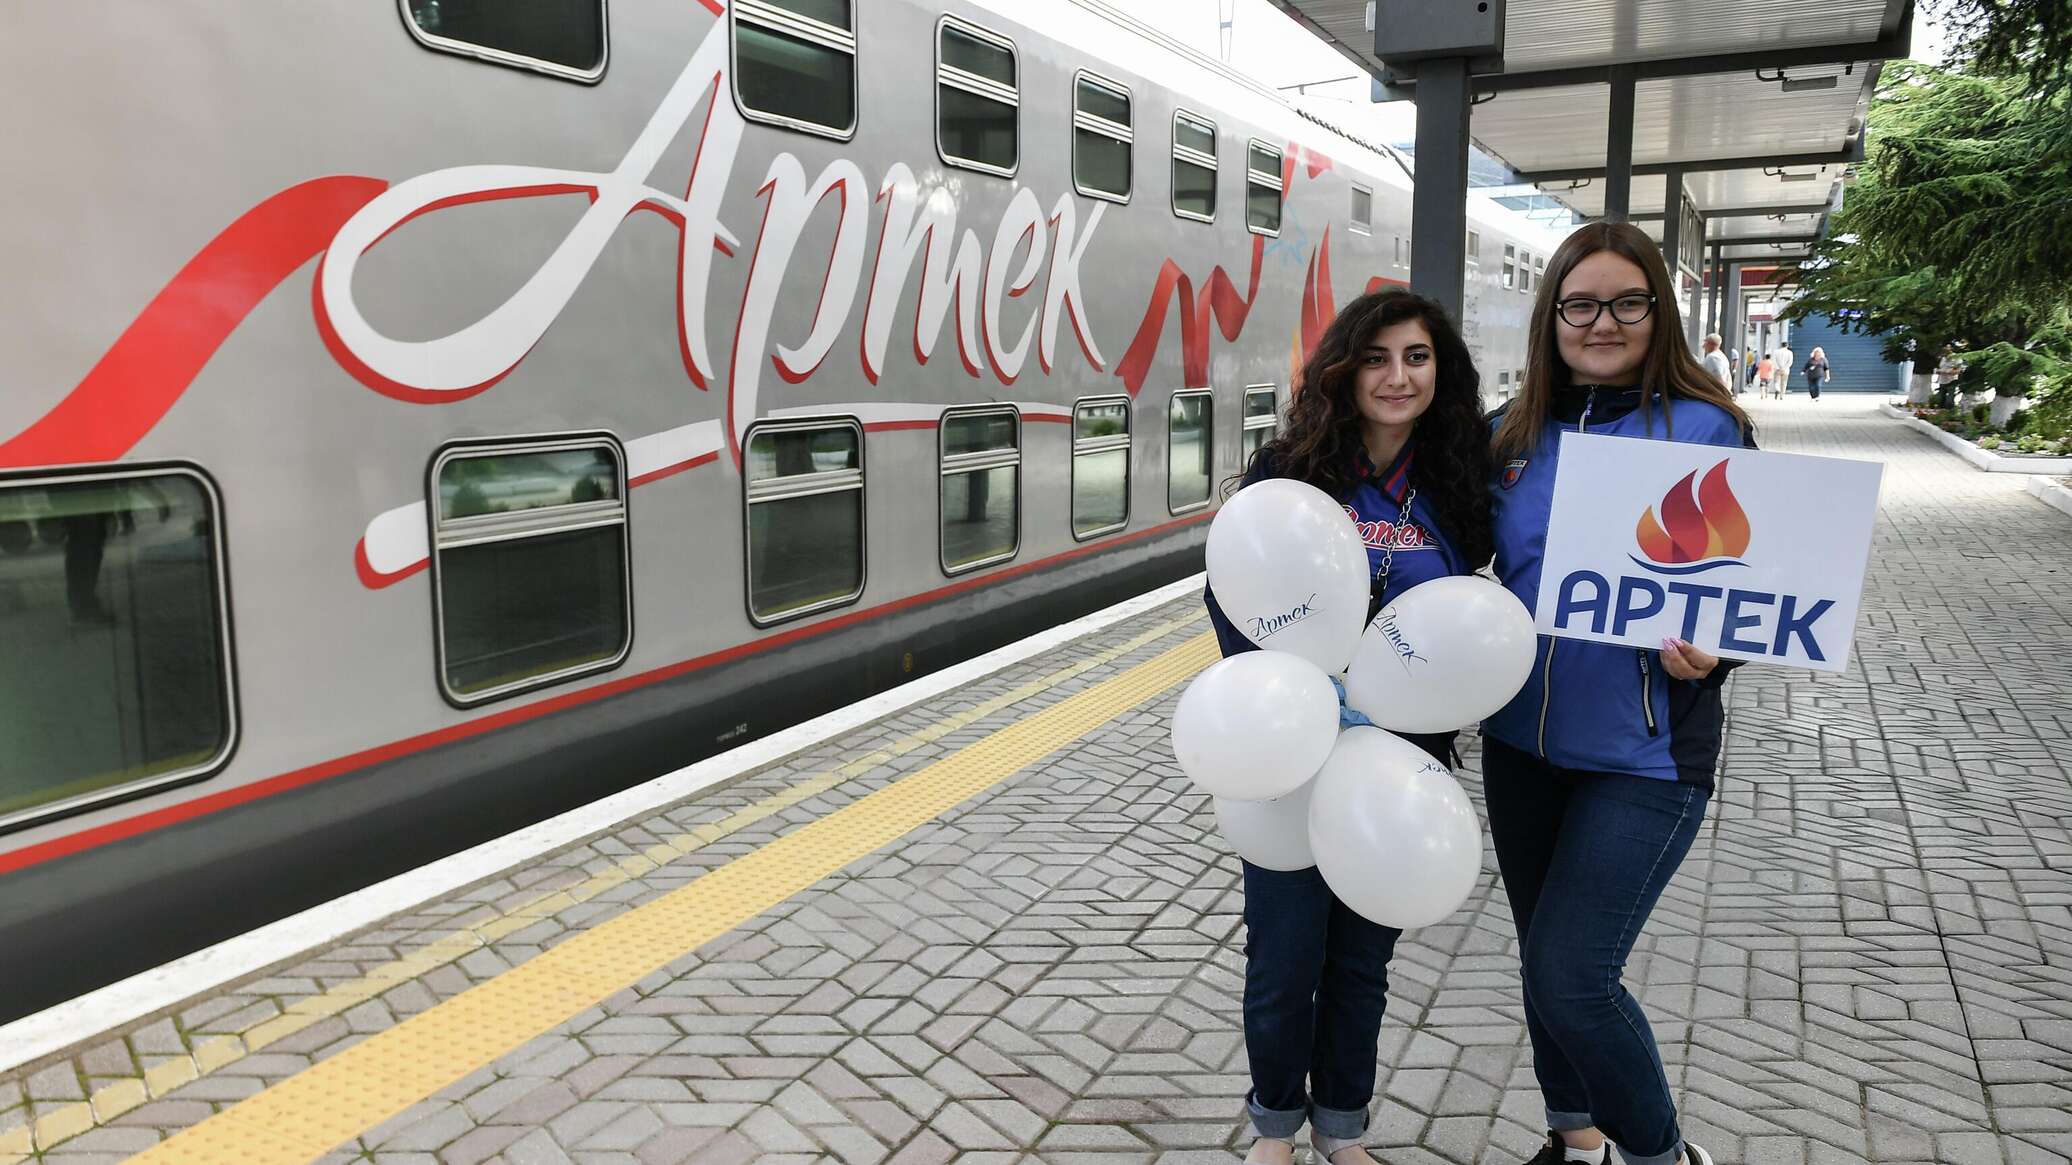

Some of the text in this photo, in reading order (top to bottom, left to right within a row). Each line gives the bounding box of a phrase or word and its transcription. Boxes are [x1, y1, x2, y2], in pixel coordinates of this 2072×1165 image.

[312, 12, 1108, 473] Артек
[1246, 592, 1319, 638] Артек
[1376, 606, 1428, 665] Артек
[1553, 569, 1836, 662] АРТЕК
